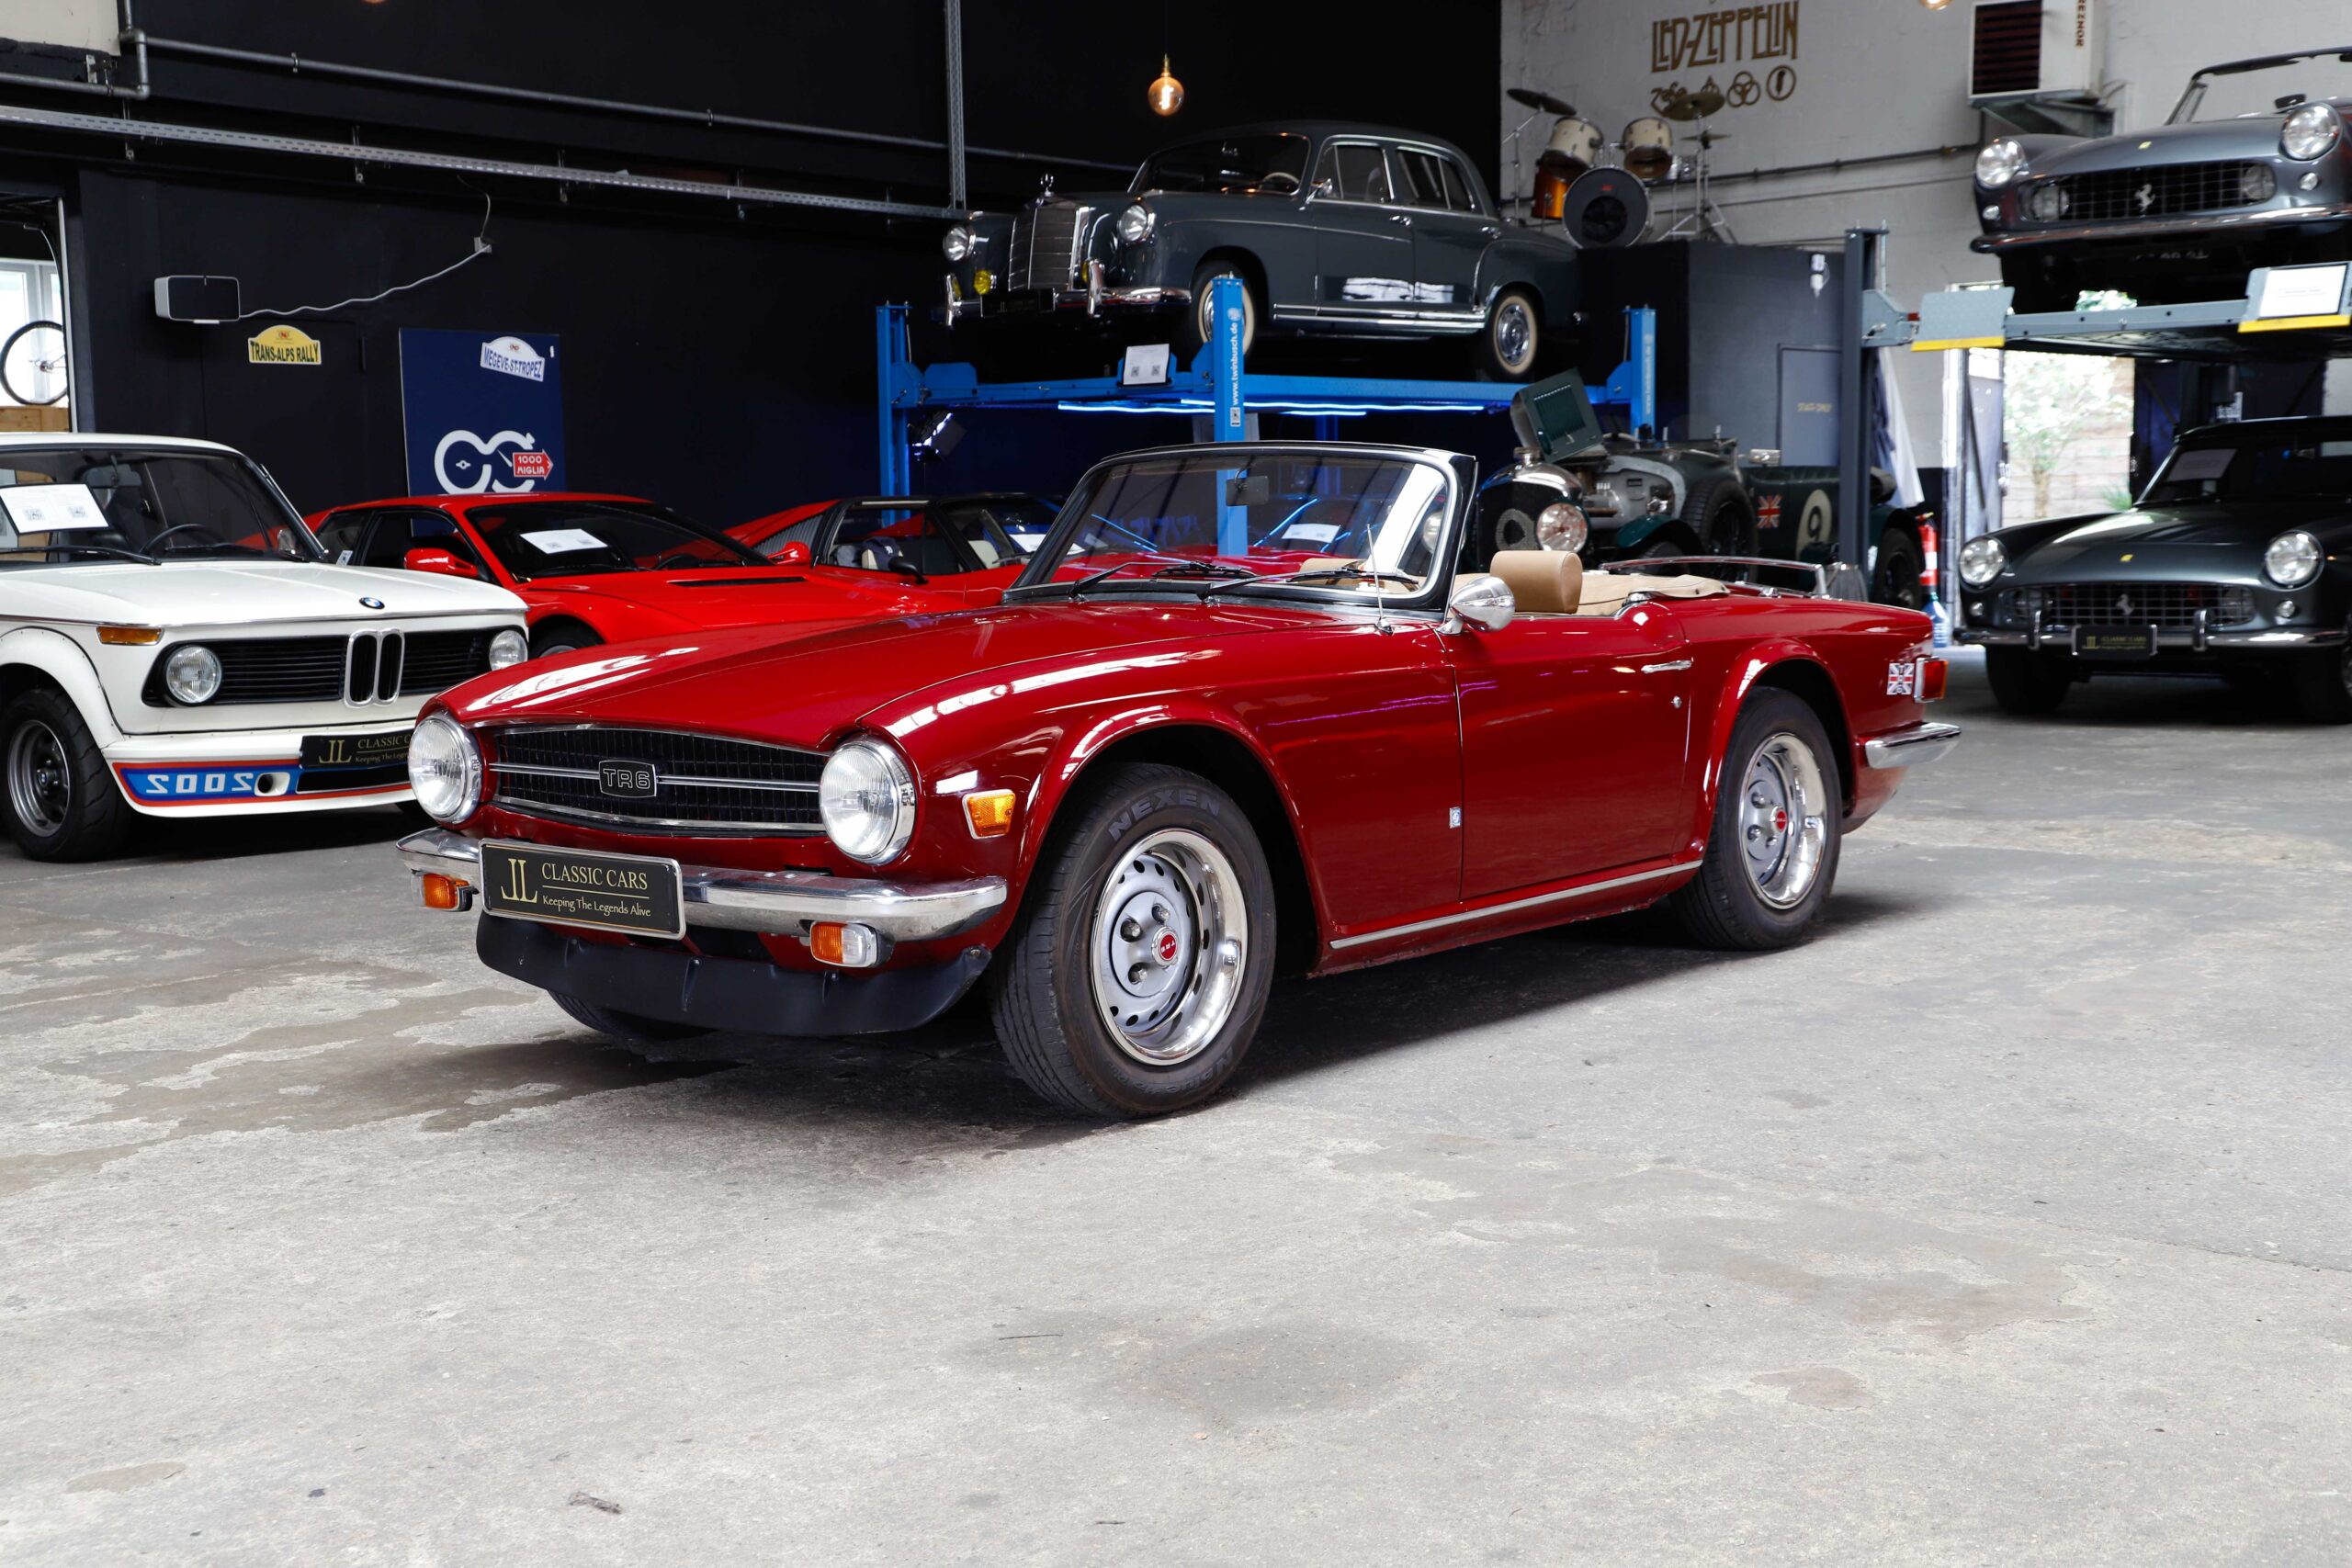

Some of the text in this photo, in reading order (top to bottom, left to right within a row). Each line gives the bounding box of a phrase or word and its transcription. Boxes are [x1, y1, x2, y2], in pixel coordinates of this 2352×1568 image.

[250, 341, 319, 363] TRANS-ALPS RALLY
[1229, 322, 1239, 405] www.twinbusch.de
[516, 466, 545, 474] MIGLIA
[517, 456, 542, 464] 1000
[357, 736, 402, 749] CLASSIC
[603, 768, 650, 789] TR6
[1108, 789, 1220, 841] NEXEN
[541, 863, 648, 890] CLASSIC CARS
[542, 895, 651, 917] Keeping The Legends Alive
